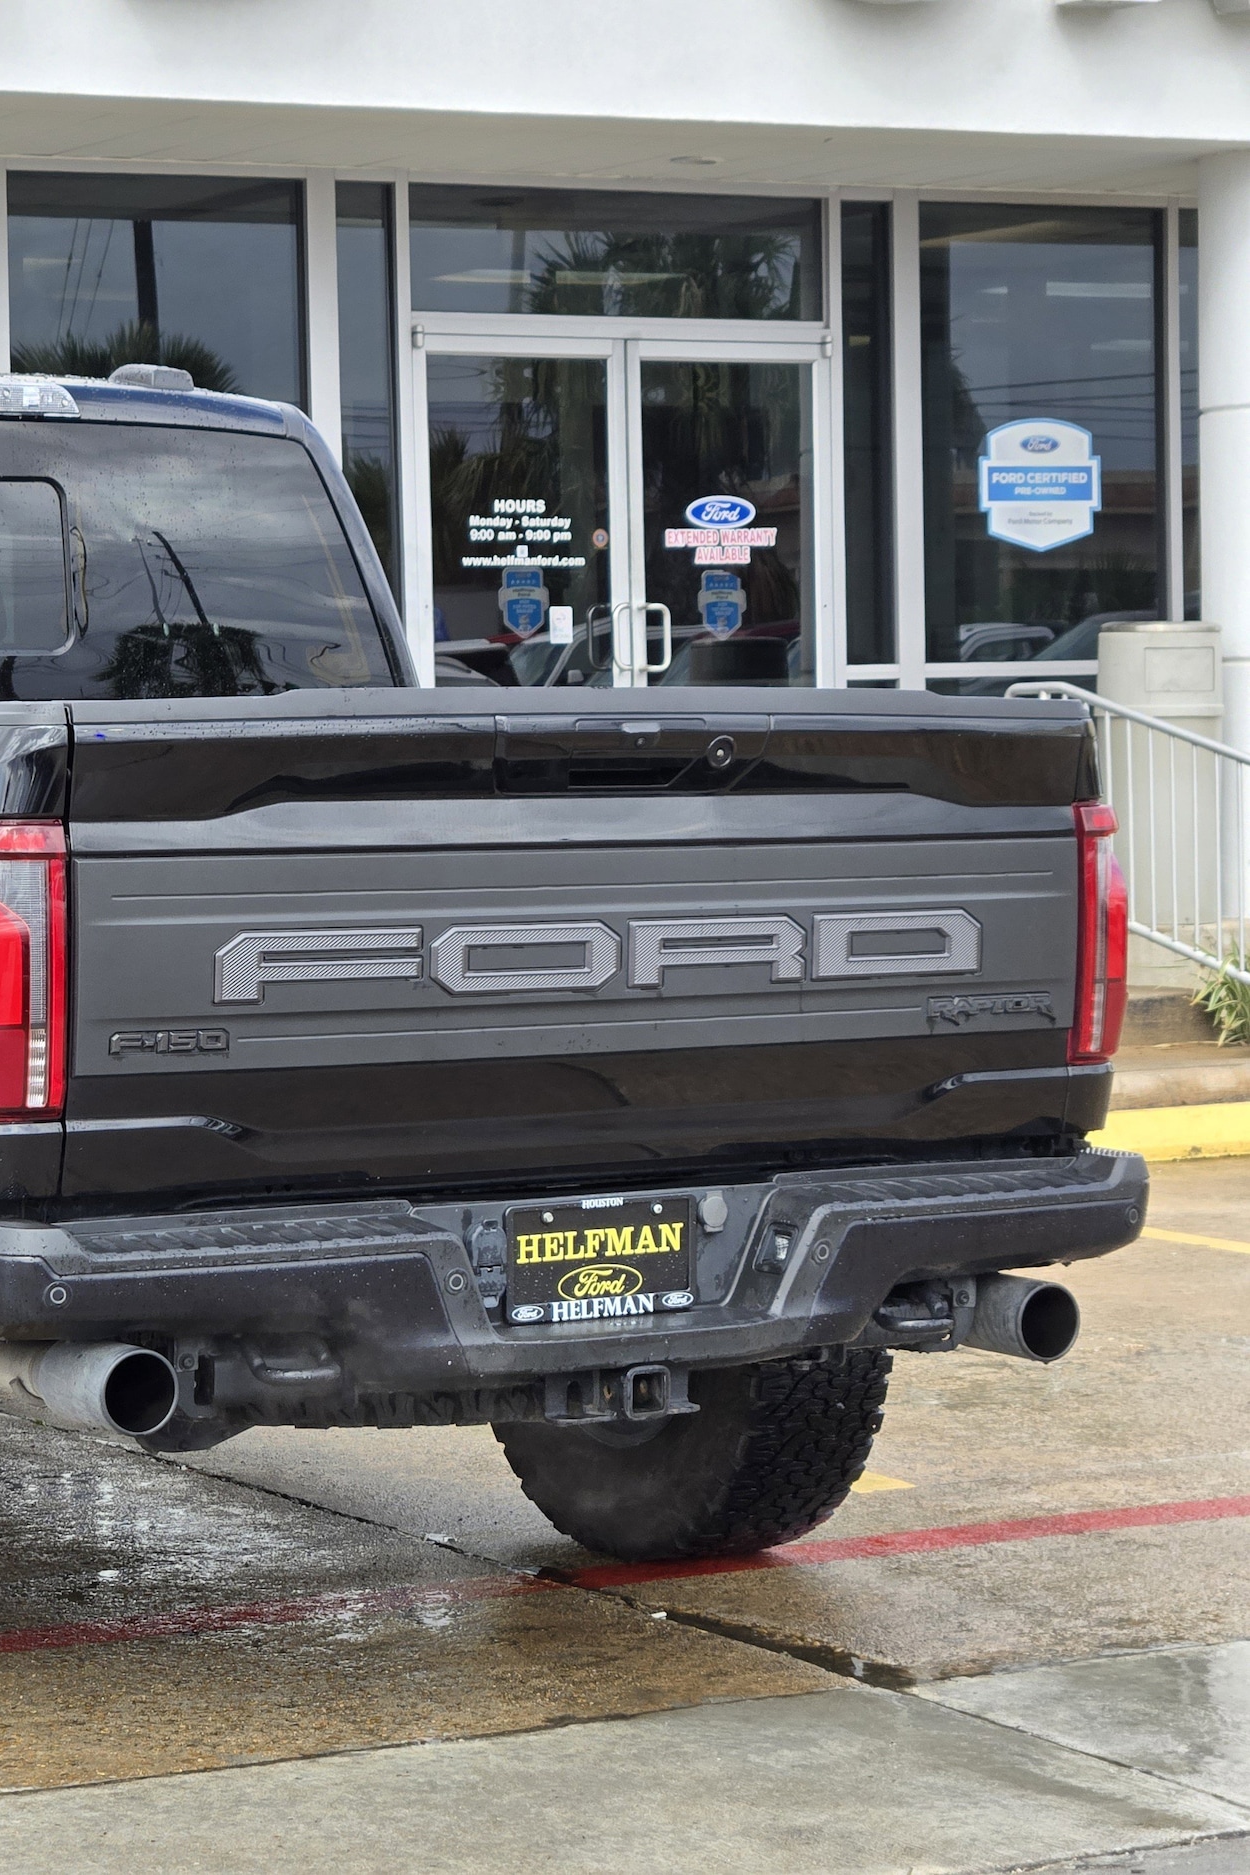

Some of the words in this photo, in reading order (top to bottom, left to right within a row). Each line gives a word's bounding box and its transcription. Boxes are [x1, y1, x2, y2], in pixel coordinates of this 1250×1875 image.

[1026, 437, 1054, 451] Ford
[991, 472, 1026, 484] FORD
[1026, 472, 1088, 484] CERTIFIED
[1014, 486, 1067, 495] PRE-OWNED
[493, 499, 547, 513] HOURS
[701, 501, 741, 521] Ford
[469, 515, 513, 529] Monday
[521, 515, 571, 529] Saturday
[469, 528, 495, 541] 9:00
[497, 531, 517, 541] am
[525, 529, 551, 541] 9:00
[552, 531, 572, 543] pm
[667, 530, 719, 545] EXTENDED
[720, 529, 776, 544] WARRANTY
[697, 547, 750, 561] AVAILABLE
[212, 906, 983, 1005] FORD
[927, 991, 1056, 1026] RAPTOR
[109, 1028, 230, 1056] F-150
[581, 1196, 625, 1210] HOUSTON
[515, 1222, 685, 1265] HELFMAN
[574, 1269, 625, 1297] Ford
[668, 1293, 688, 1305] Ford
[516, 1307, 540, 1320] Ford
[550, 1292, 656, 1323] HELFMAN
